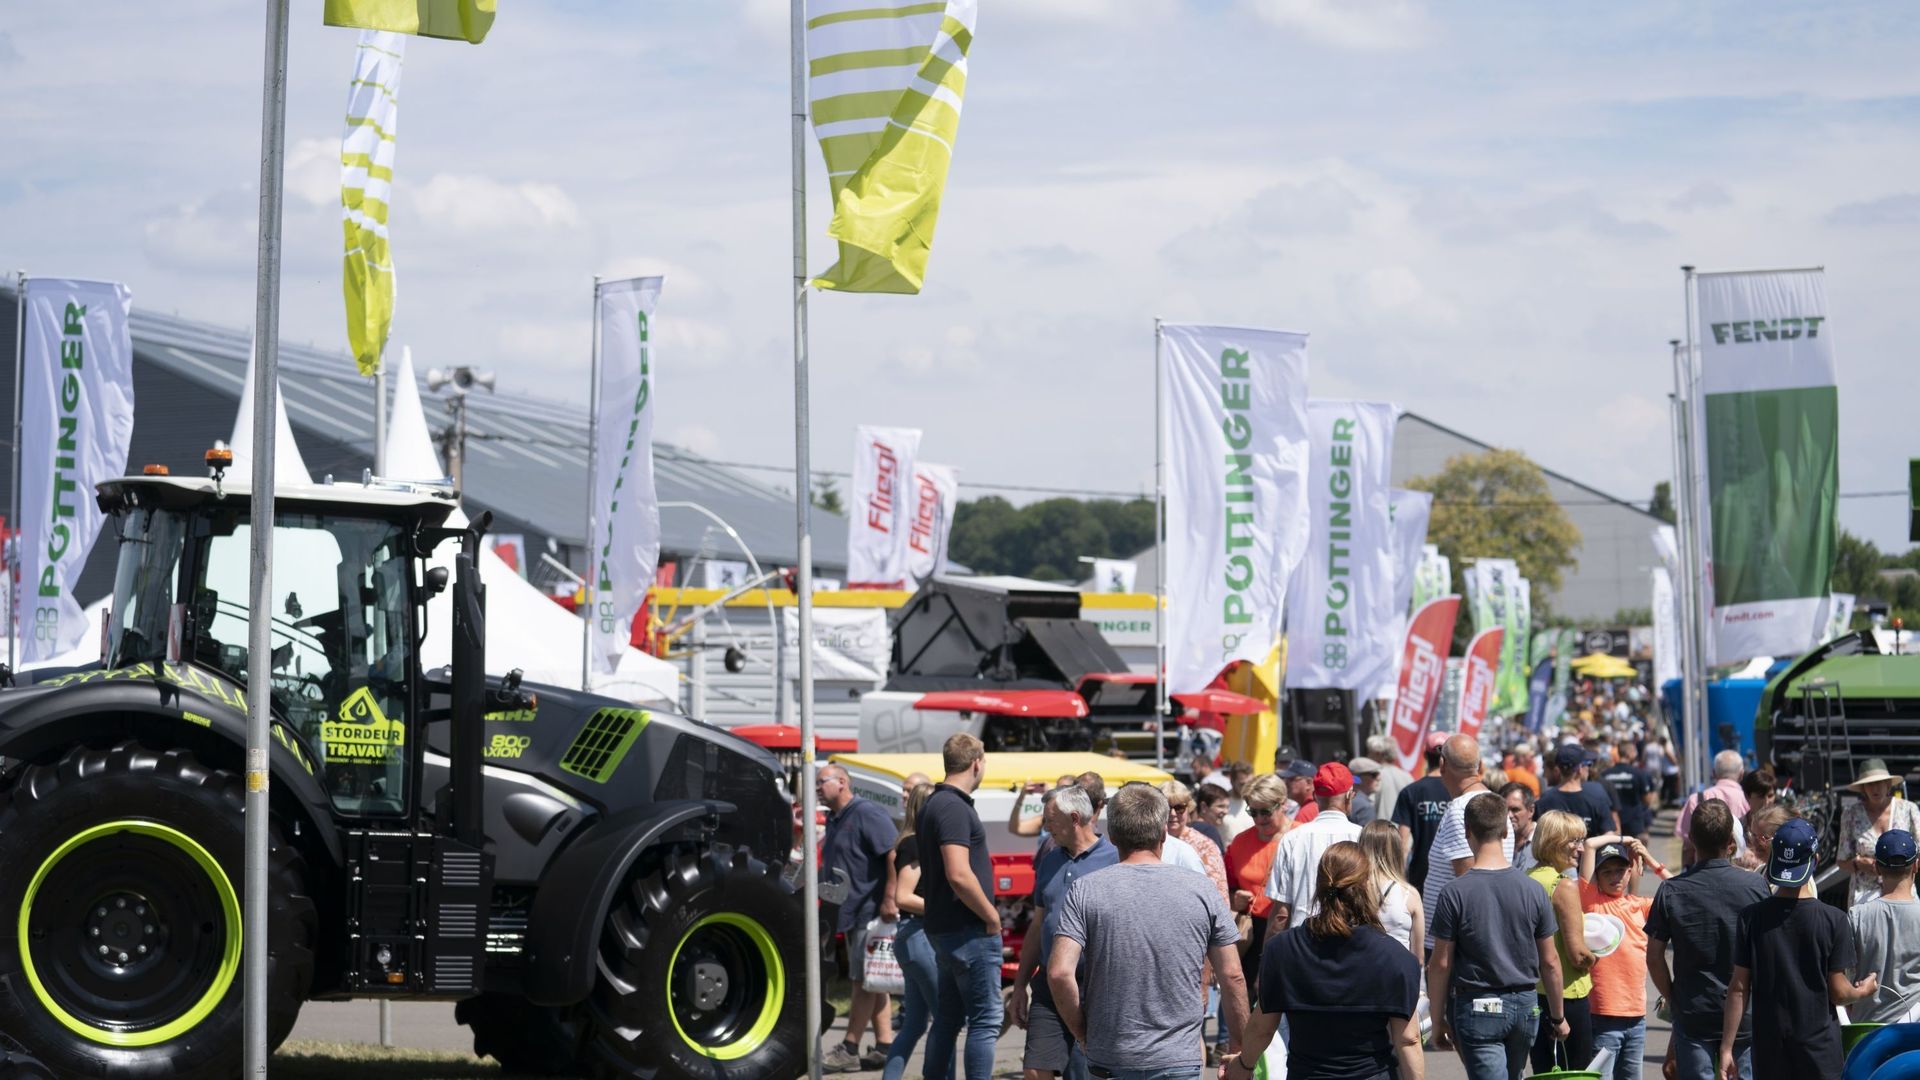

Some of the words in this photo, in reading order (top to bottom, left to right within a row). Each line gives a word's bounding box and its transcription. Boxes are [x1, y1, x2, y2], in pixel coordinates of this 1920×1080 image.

[1711, 316, 1825, 345] FENDT
[868, 440, 898, 534] Fliegl
[909, 474, 940, 555] Fliegl
[1220, 346, 1255, 624] PÖTTINGER
[1324, 417, 1356, 637] PÖTTINGER
[1725, 610, 1775, 624] fendt.com
[1397, 634, 1440, 733] Fliegl
[1462, 654, 1493, 728] Fliegl
[326, 726, 401, 741] STORDEUR
[491, 734, 531, 748] 800
